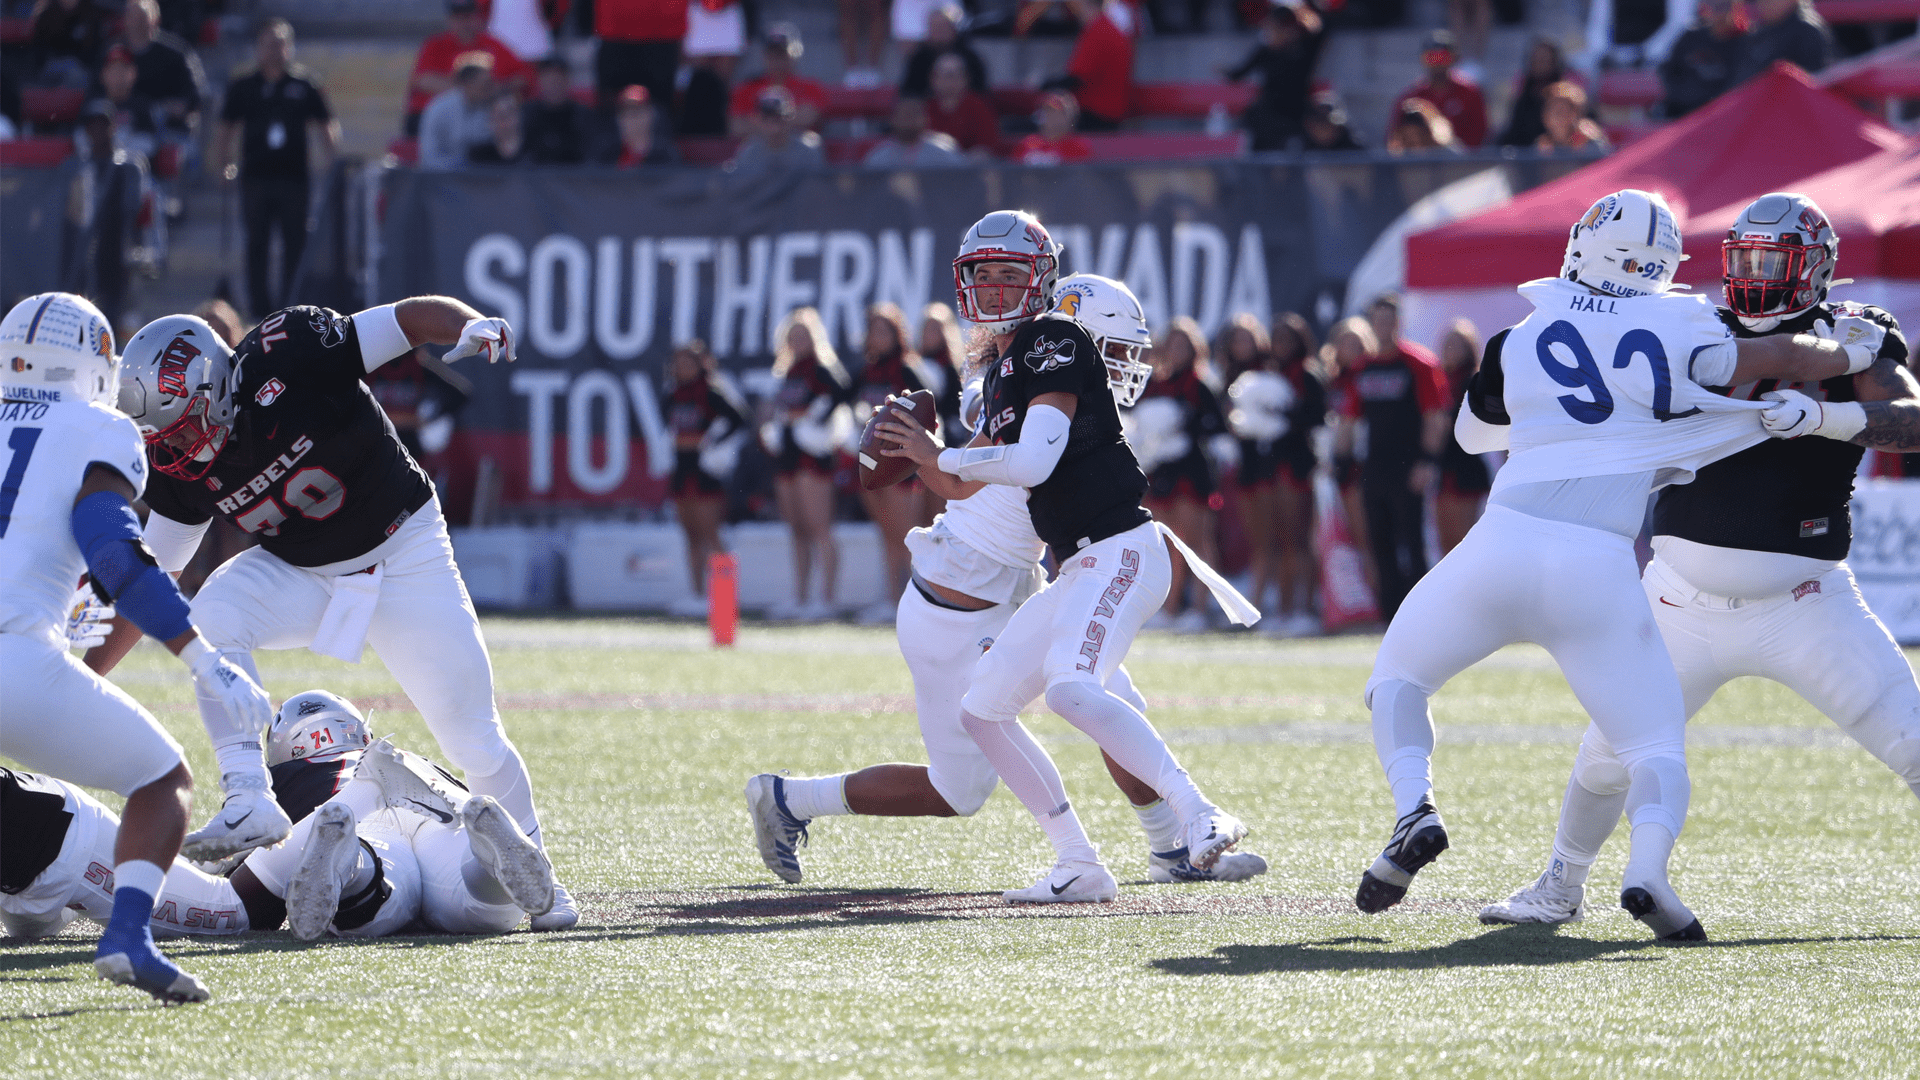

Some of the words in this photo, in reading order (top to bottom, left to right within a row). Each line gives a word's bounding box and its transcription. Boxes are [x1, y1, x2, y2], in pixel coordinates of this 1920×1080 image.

[1642, 262, 1664, 280] 92
[464, 229, 936, 361] SOUTHERN
[1570, 295, 1618, 315] HALL
[158, 336, 202, 398] UNLV
[1536, 319, 1704, 425] 92
[3, 386, 61, 402] LUELINE
[255, 378, 286, 406] 150
[989, 405, 1016, 440] ELS
[216, 434, 314, 514] REBELS
[235, 466, 347, 536] 70
[1076, 620, 1106, 675] LAS
[1093, 548, 1140, 619] VEGAS
[310, 727, 334, 749] 71
[184, 907, 238, 930] LAS
